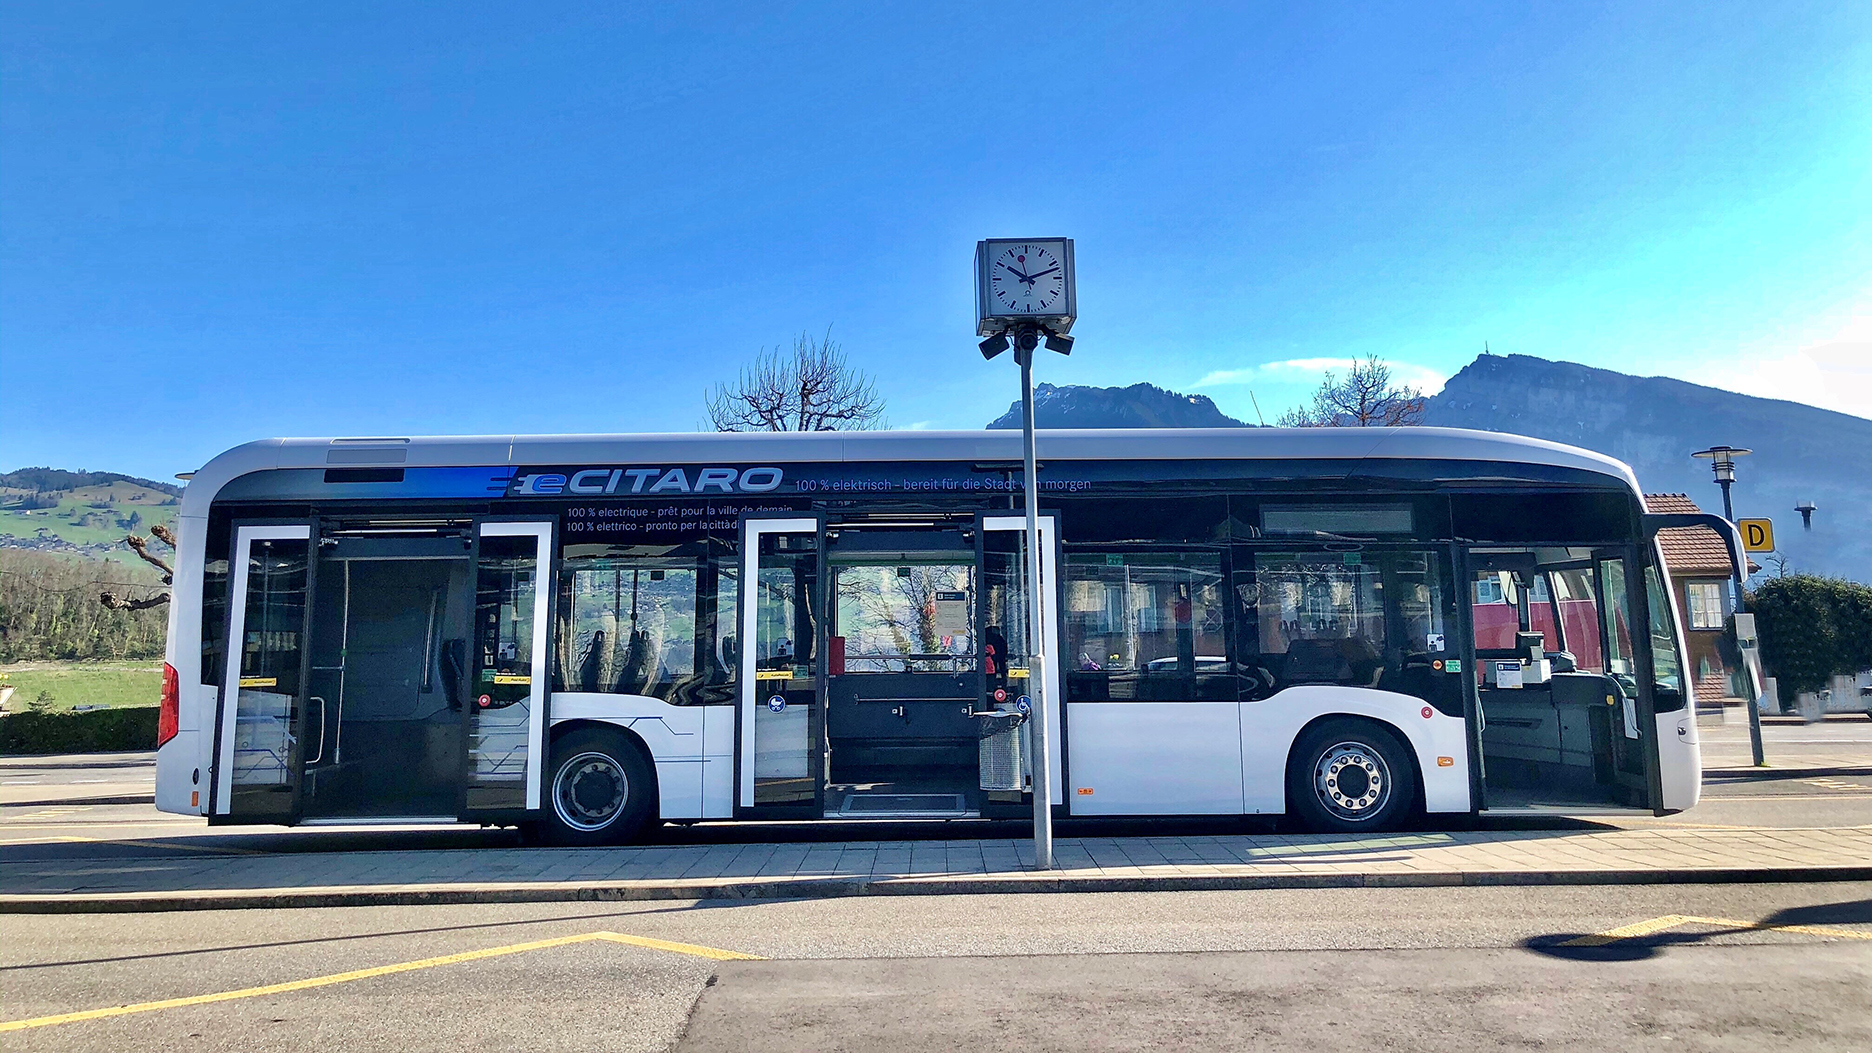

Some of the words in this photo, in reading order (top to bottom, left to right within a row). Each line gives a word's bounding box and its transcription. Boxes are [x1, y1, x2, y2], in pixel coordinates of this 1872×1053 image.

[795, 479, 817, 491] 100
[820, 479, 830, 491] %
[833, 478, 892, 491] elektrisch
[903, 478, 939, 491] bereit
[941, 478, 959, 490] für
[962, 478, 980, 490] die
[984, 477, 1016, 490] Stadt
[1020, 480, 1041, 489] vn
[1045, 480, 1091, 492] morgen
[568, 507, 586, 517] 100
[588, 507, 596, 517] %
[598, 506, 649, 518] electrique
[657, 506, 678, 518] prêt
[680, 507, 704, 517] pour
[706, 505, 716, 515] la
[718, 505, 738, 515] ville
[567, 522, 584, 531] 100
[586, 522, 595, 531] %
[596, 521, 637, 531] elettrico
[645, 521, 678, 533] pronto
[680, 522, 697, 532] per
[699, 520, 708, 530] la
[1748, 524, 1765, 546] D
